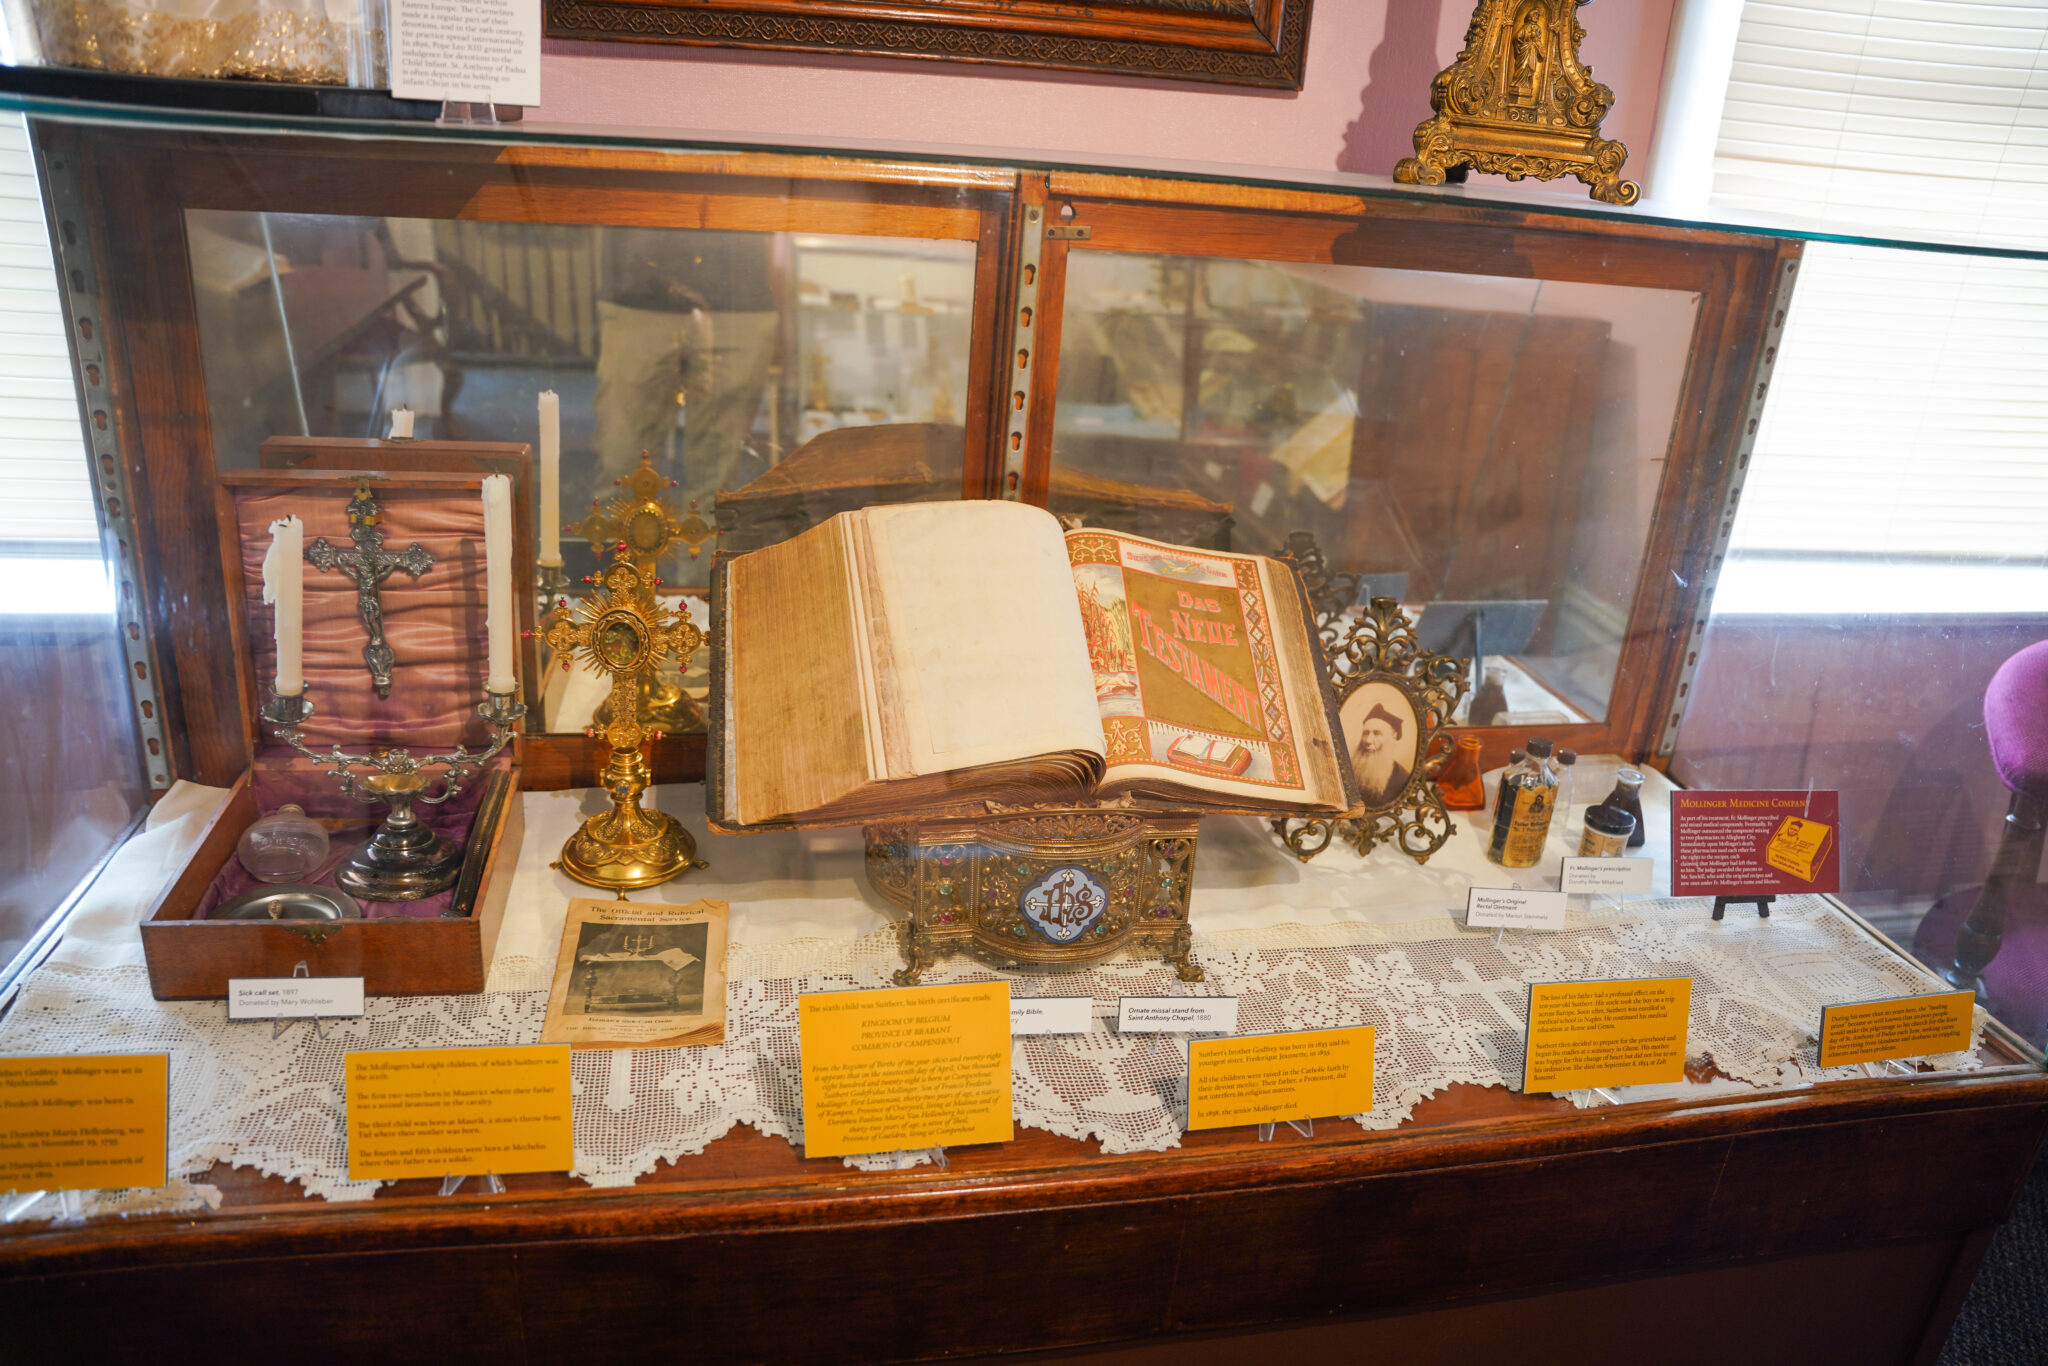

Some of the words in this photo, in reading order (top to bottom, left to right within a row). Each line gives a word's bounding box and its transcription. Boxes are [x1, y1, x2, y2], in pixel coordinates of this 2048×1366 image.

[1132, 600, 1262, 732] TESTAMENT
[1680, 798, 1727, 808] MOLLINGER
[1730, 798, 1769, 808] MEDICINE
[1772, 798, 1807, 808] COMPAN
[861, 1018, 902, 1027] KINGDOM
[915, 1015, 951, 1024] BELGIUM
[861, 1029, 901, 1039] PROVINCE
[914, 1026, 951, 1035] BRABANT
[851, 1042, 891, 1051] COMMON
[904, 1037, 961, 1048] CAMPENHOUT
[1220, 1073, 1246, 1081] children
